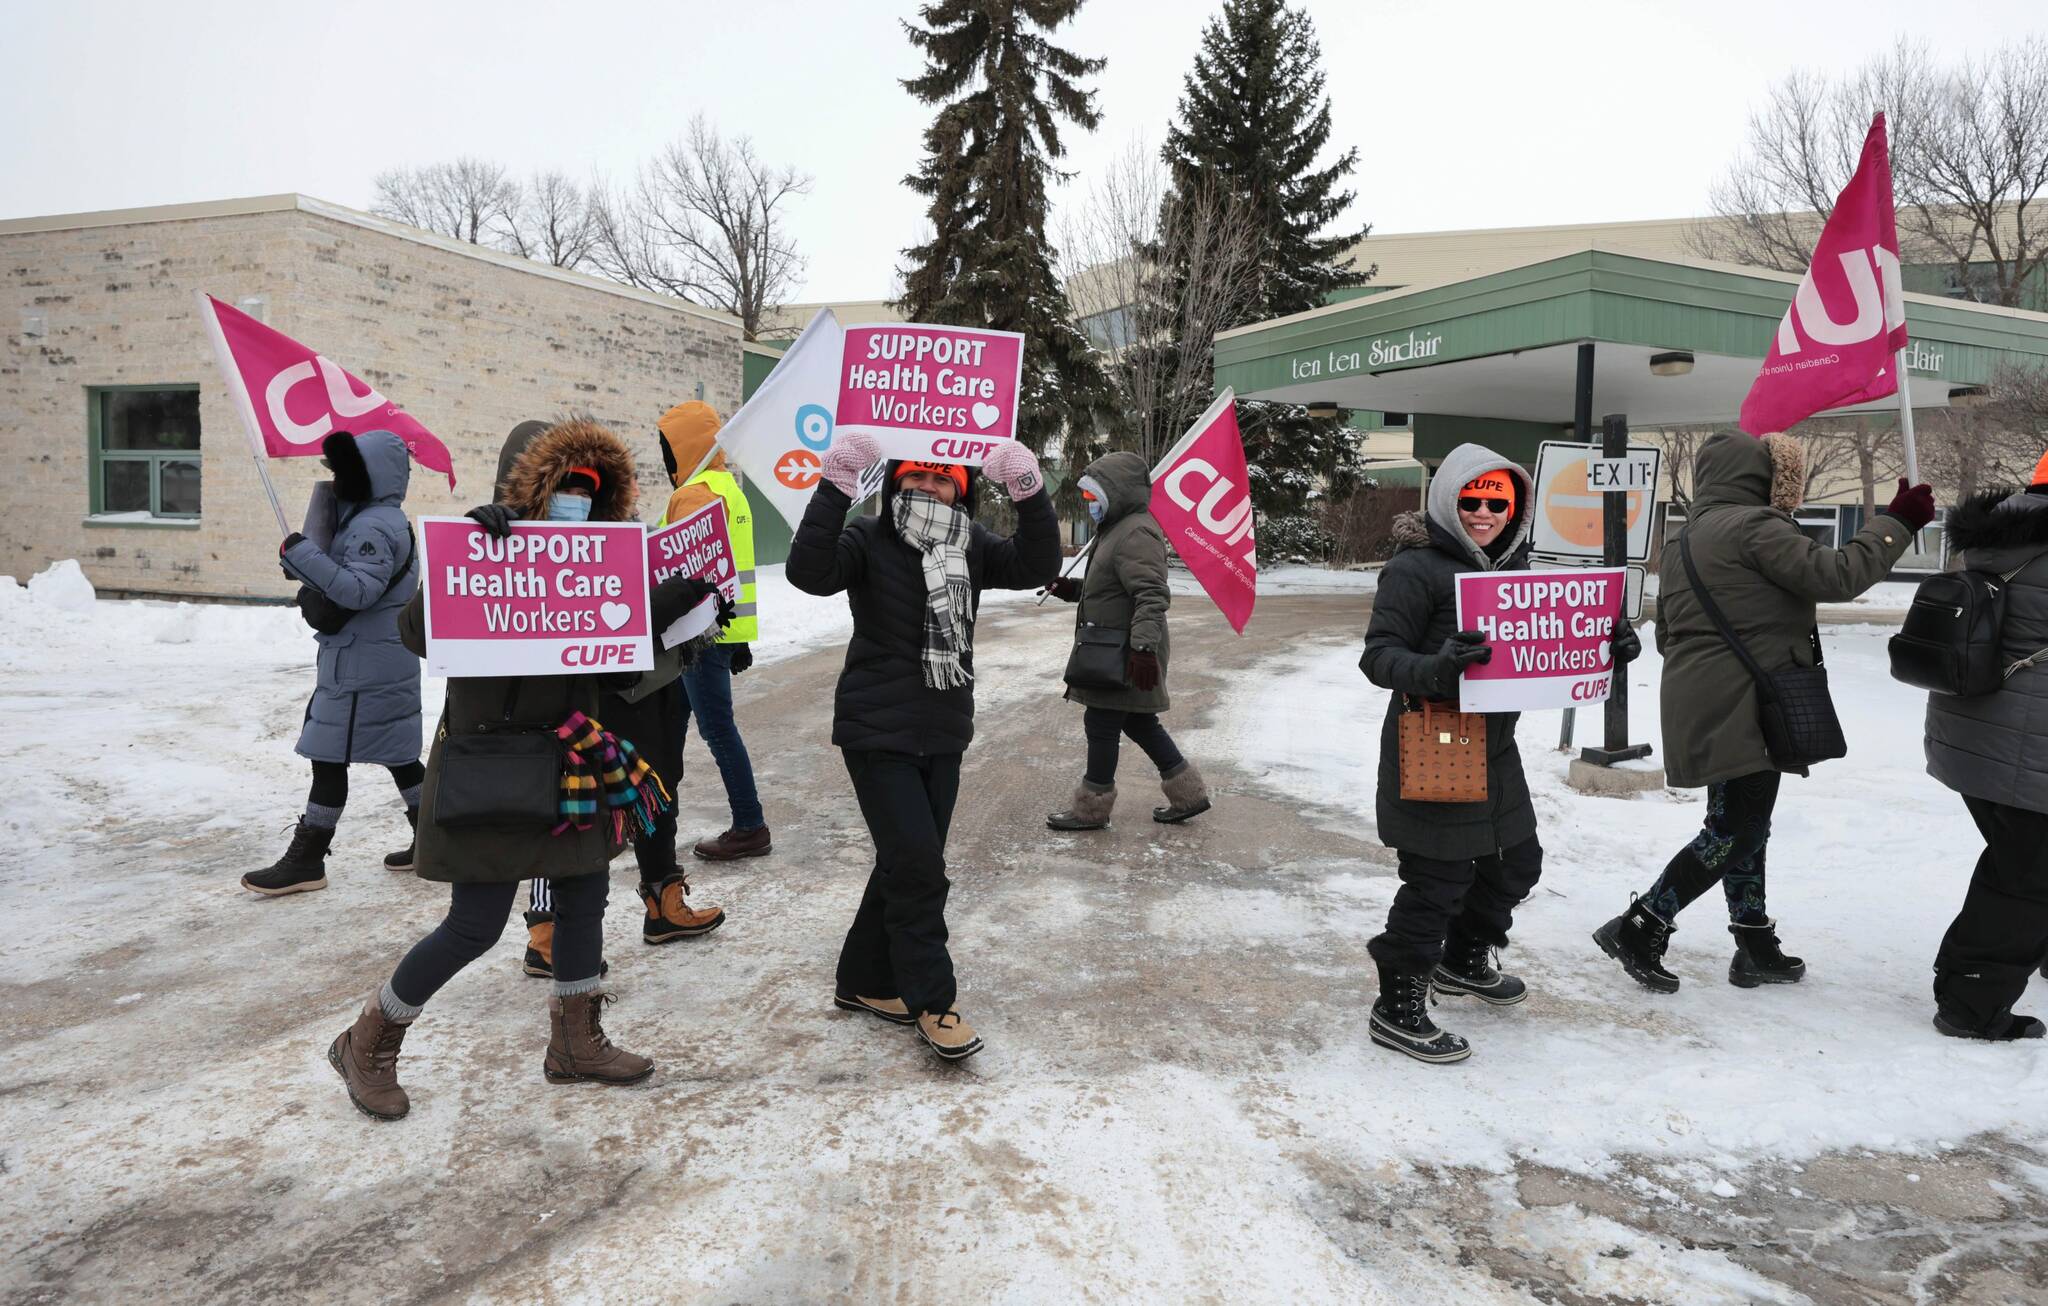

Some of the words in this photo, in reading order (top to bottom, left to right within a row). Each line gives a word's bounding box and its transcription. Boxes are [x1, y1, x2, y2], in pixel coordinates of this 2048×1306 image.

[867, 333, 986, 367] SUPPORT
[1292, 358, 1321, 380] ten
[1329, 351, 1360, 373] ten
[1368, 331, 1442, 367] Sinclair
[849, 364, 928, 393] Health
[936, 368, 995, 399] Care
[871, 394, 967, 427] Workers
[1464, 479, 1504, 493] CUPE
[1593, 462, 1650, 486] EXIT
[467, 531, 607, 564] SUPPORT
[659, 513, 713, 560] SUPPORT
[702, 539, 723, 565] Care
[446, 565, 547, 599] Health
[555, 568, 622, 598] Care
[1497, 579, 1608, 610] SUPPORT
[483, 602, 596, 633] Workers
[1477, 611, 1565, 642] Health
[1570, 611, 1613, 639] Care
[561, 643, 636, 667] CUPE
[1511, 643, 1596, 673] Workers
[1571, 677, 1609, 701] CUPE
